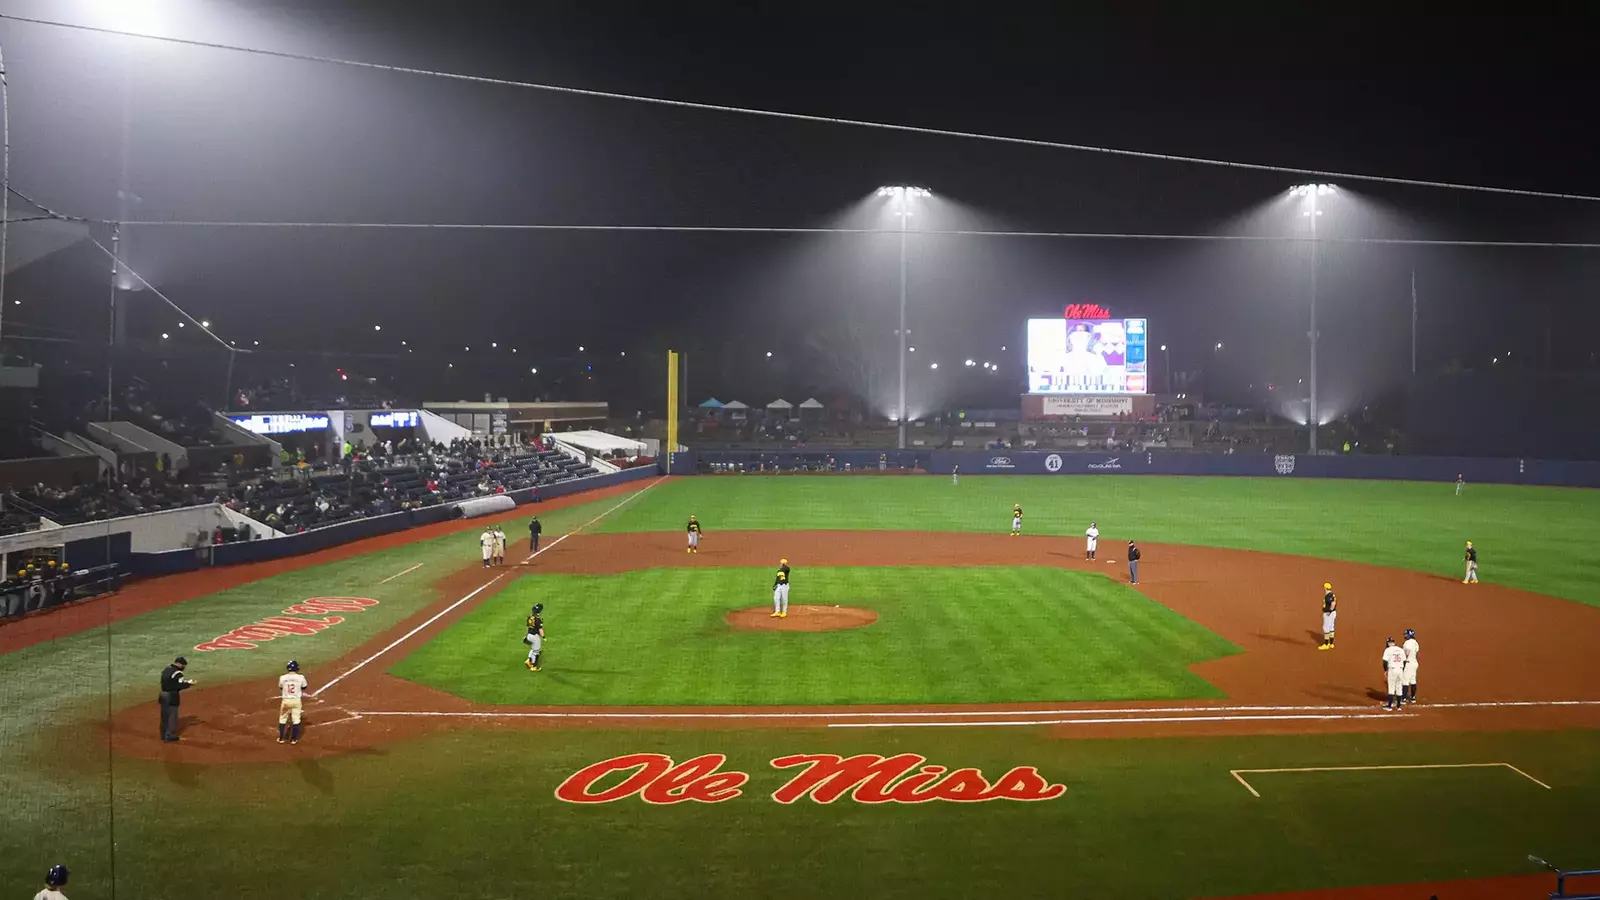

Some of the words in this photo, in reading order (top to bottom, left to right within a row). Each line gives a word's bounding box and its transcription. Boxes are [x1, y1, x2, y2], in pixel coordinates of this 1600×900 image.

[1065, 304, 1082, 319] Ole
[1082, 304, 1110, 319] Miss
[1048, 459, 1059, 470] 41
[286, 683, 296, 694] 12
[554, 752, 750, 805] Ole
[769, 752, 1067, 805] Miss
